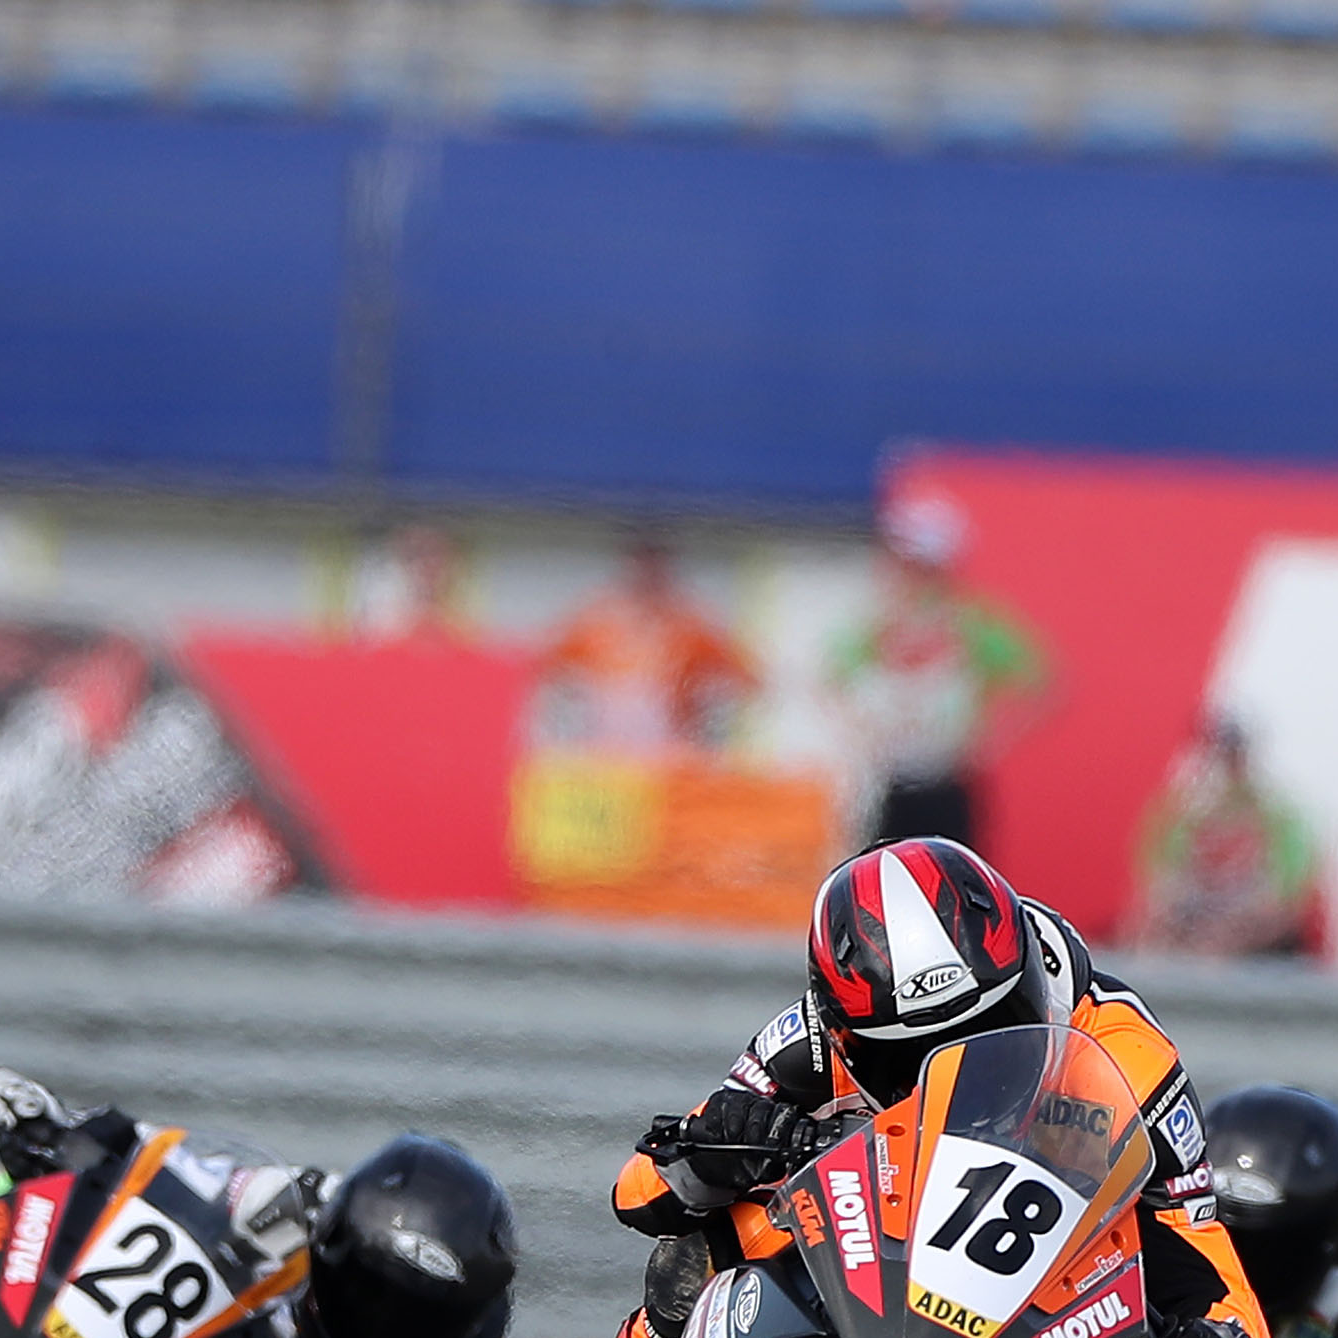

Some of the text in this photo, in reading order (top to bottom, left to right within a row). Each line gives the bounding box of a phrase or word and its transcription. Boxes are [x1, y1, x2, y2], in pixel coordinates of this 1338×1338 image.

[910, 969, 959, 998] X-lite
[790, 1188, 826, 1248] KTM
[827, 1170, 876, 1270] MOTUL
[925, 1161, 1063, 1276] 18
[915, 1288, 987, 1338] ADAC
